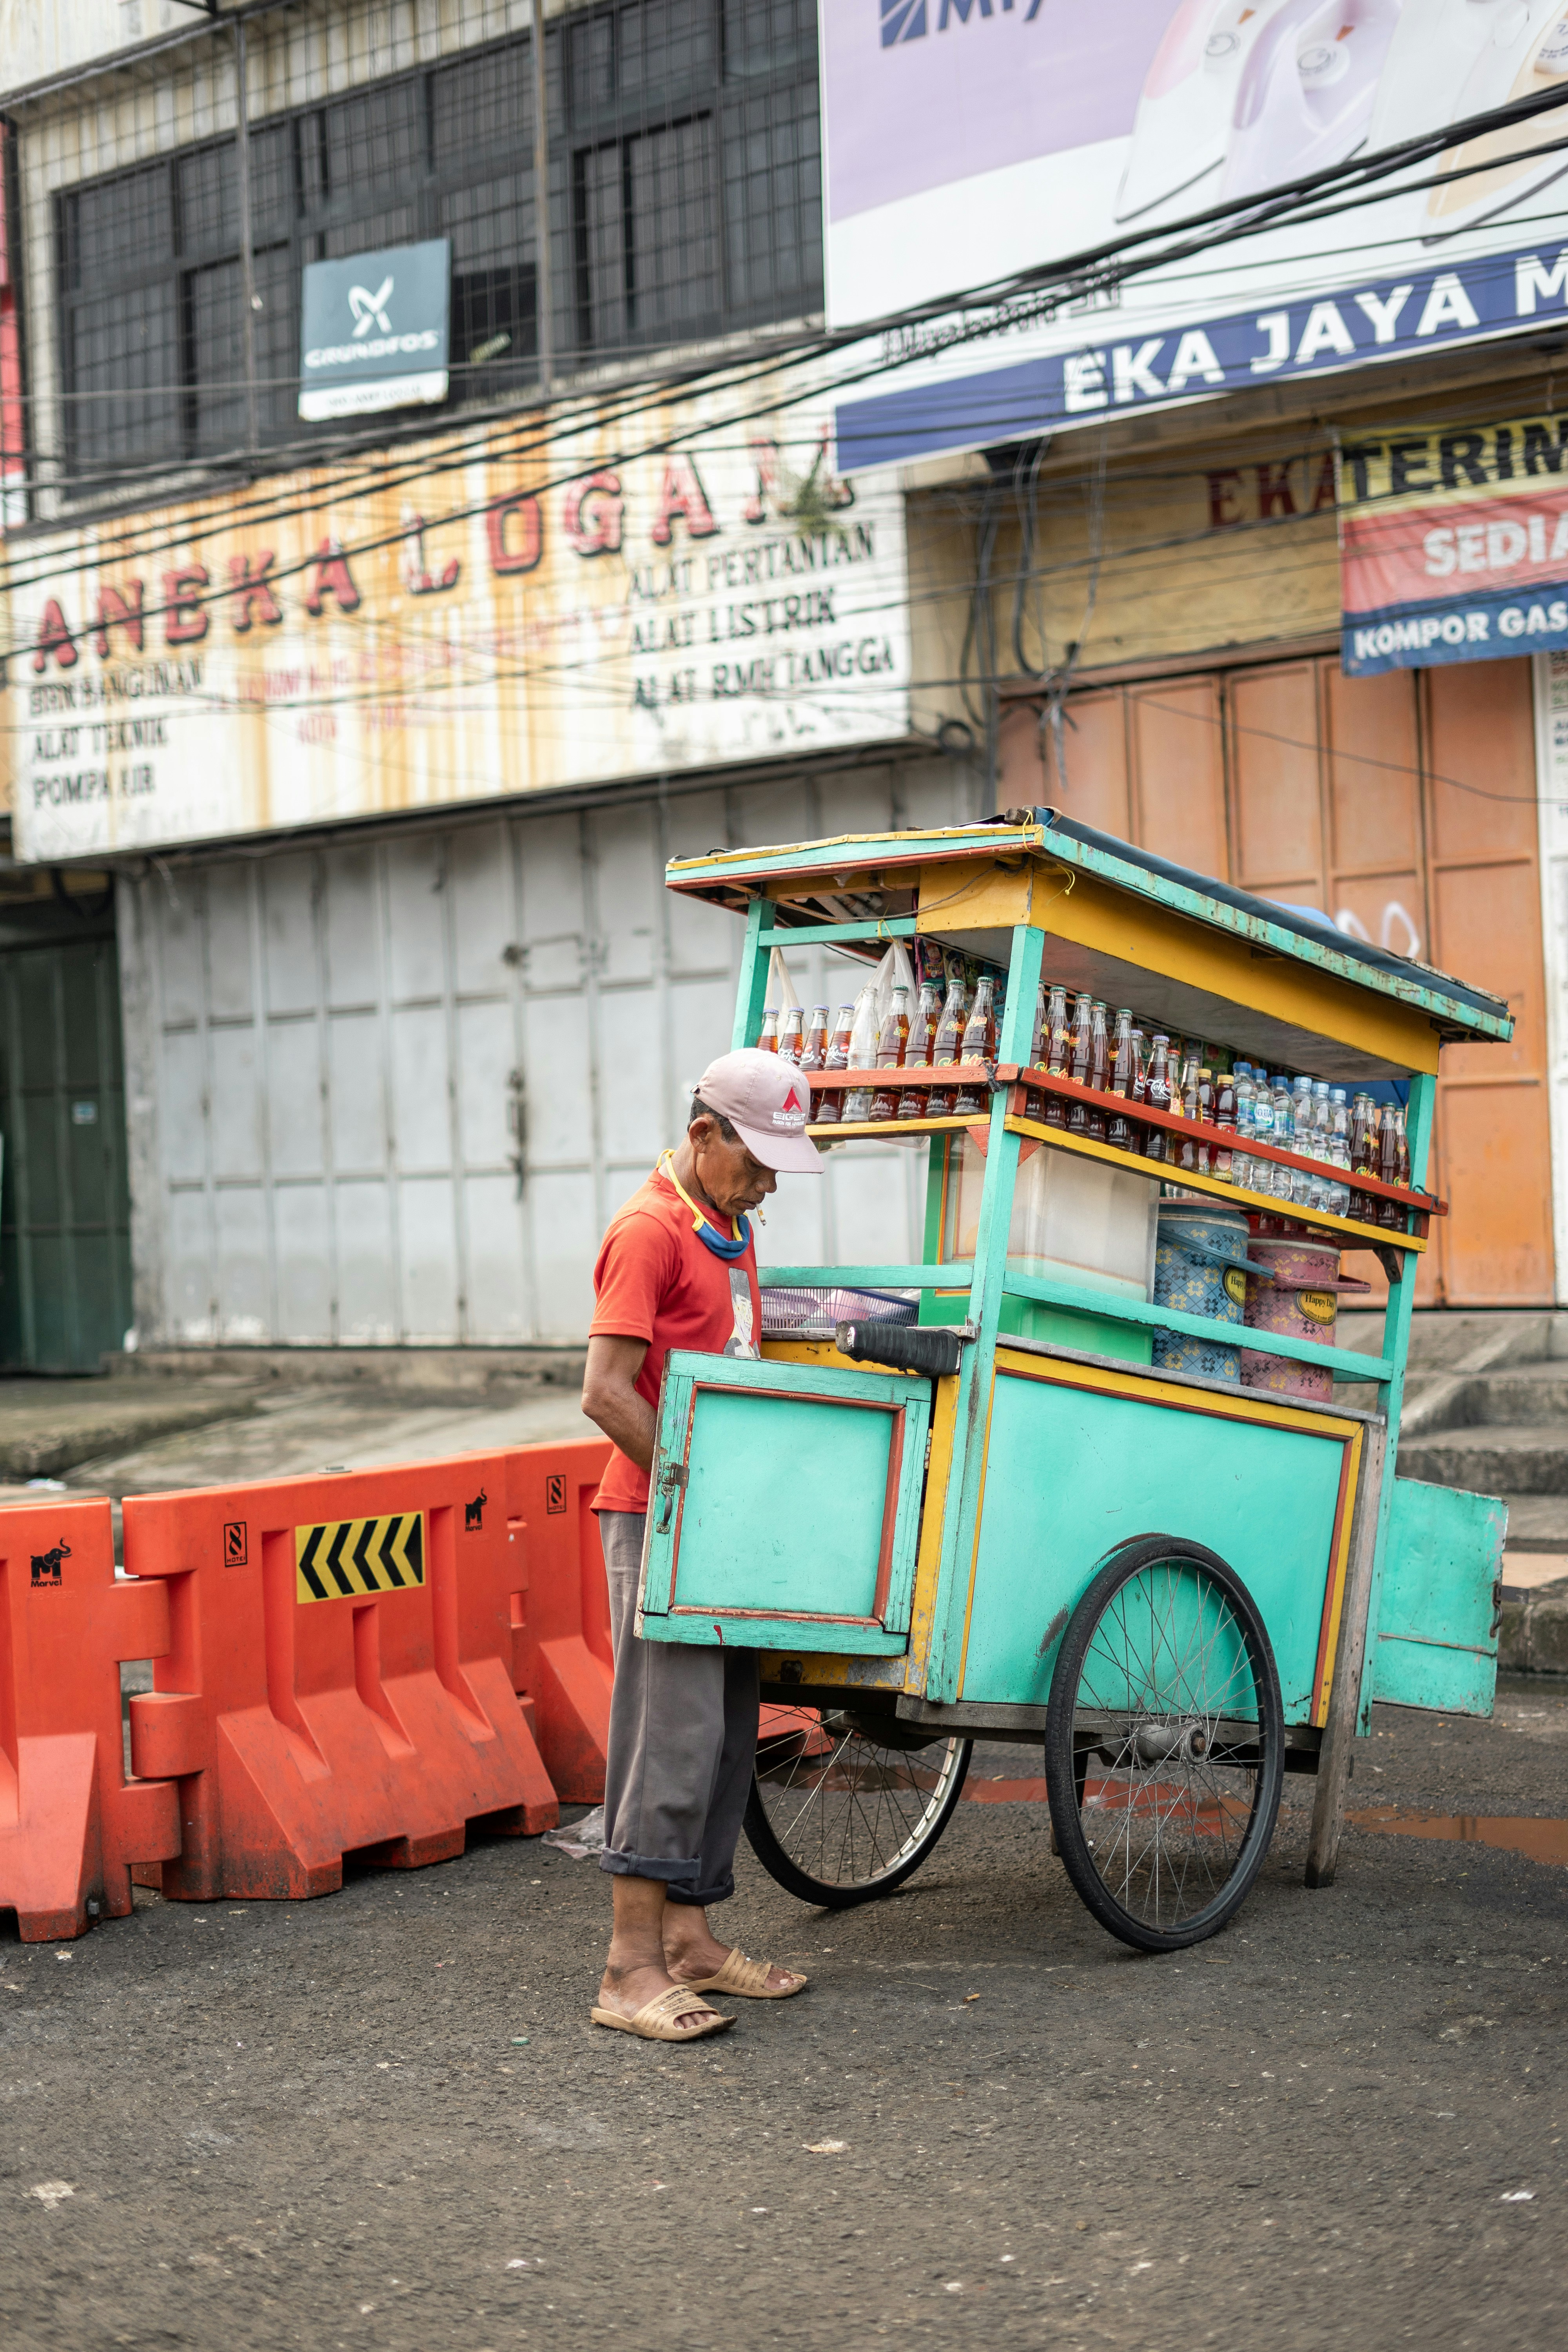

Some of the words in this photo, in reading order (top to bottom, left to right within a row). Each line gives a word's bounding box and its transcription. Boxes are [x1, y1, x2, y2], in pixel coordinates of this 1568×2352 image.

[1063, 330, 1225, 414] EKA
[1249, 273, 1481, 376] JAYA
[707, 522, 876, 591] PERTANIAN
[32, 535, 361, 673] ANEKA
[632, 612, 697, 655] ALAT
[708, 586, 837, 643] LISTRIK
[1354, 610, 1490, 660] KOMPOR
[1497, 600, 1568, 637] GAS
[632, 668, 696, 711] ALAT
[712, 657, 776, 701] RMH
[784, 636, 895, 686] TANGGA
[773, 1112, 806, 1121] EIGER
[1305, 1294, 1326, 1308] Happy
[31, 1579, 62, 1588] Marvel
